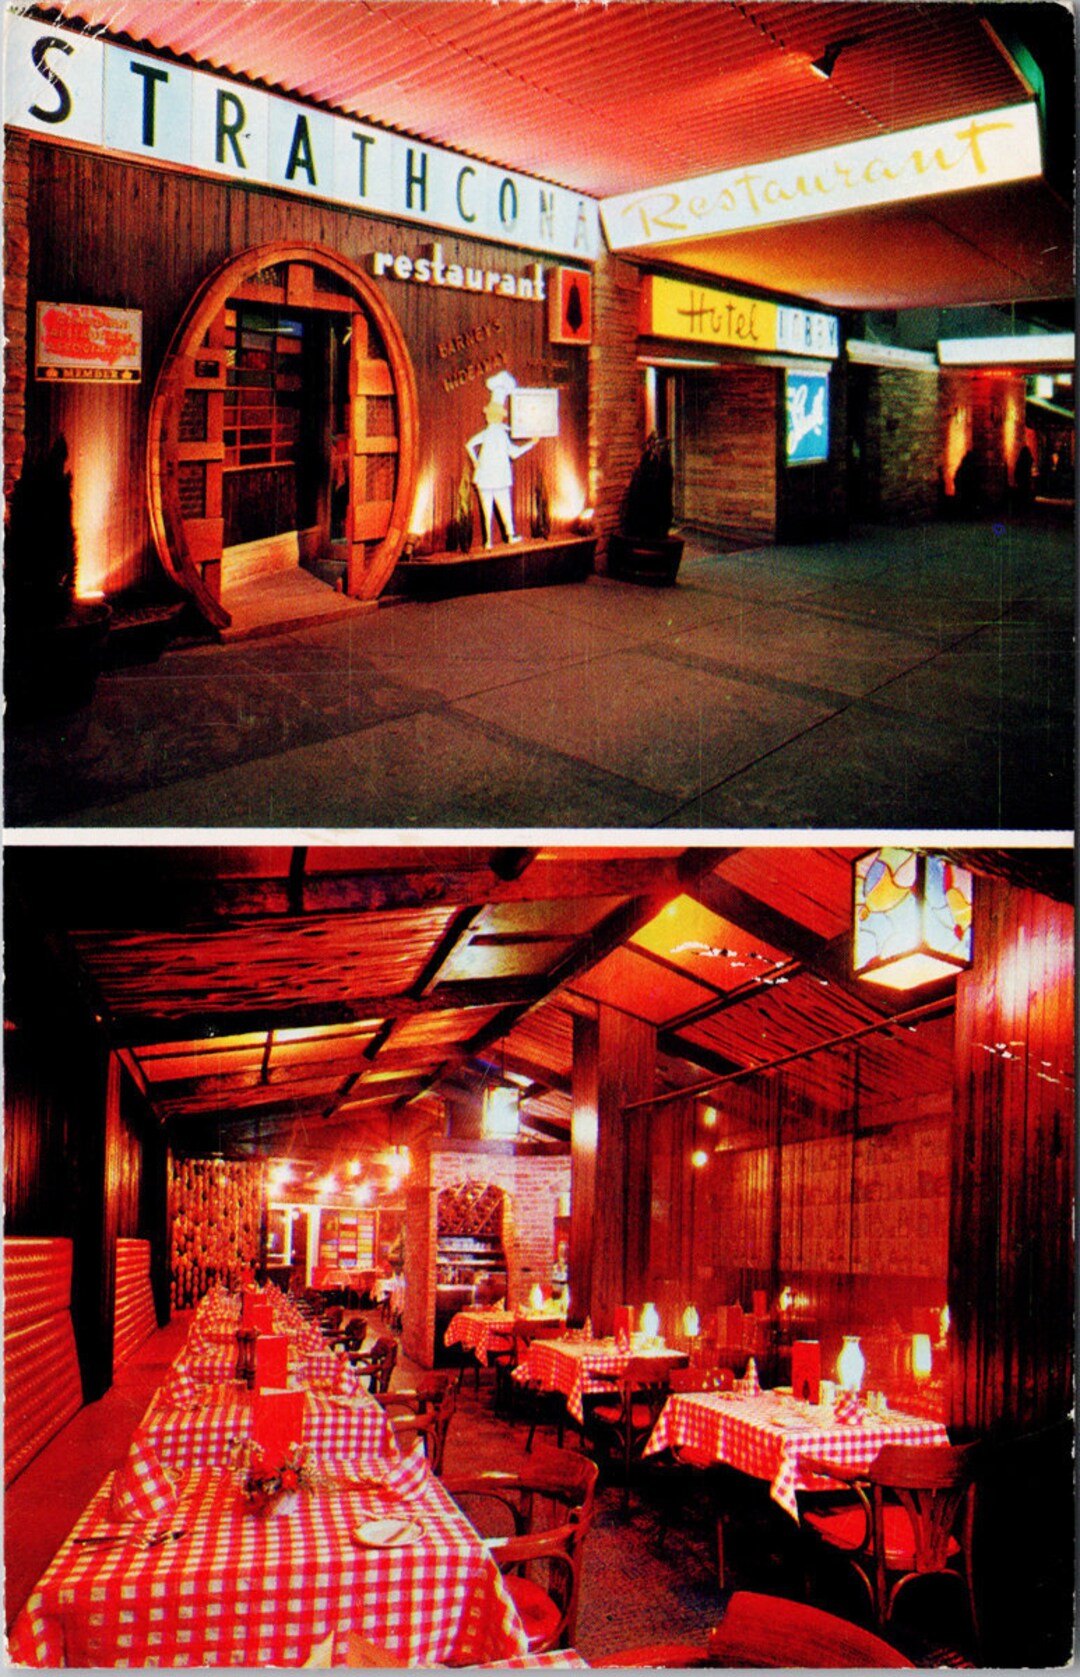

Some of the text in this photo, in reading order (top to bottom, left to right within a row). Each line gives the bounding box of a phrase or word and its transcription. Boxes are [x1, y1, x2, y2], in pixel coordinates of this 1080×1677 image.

[28, 36, 591, 250] STRATHCONA
[621, 119, 1014, 237] Restaurant
[373, 242, 546, 300] restaurant
[437, 318, 502, 358] BARNEY'S
[677, 289, 759, 341] Hotel
[63, 368, 118, 379] MEMBER
[442, 352, 507, 393] HIDEAWAY
